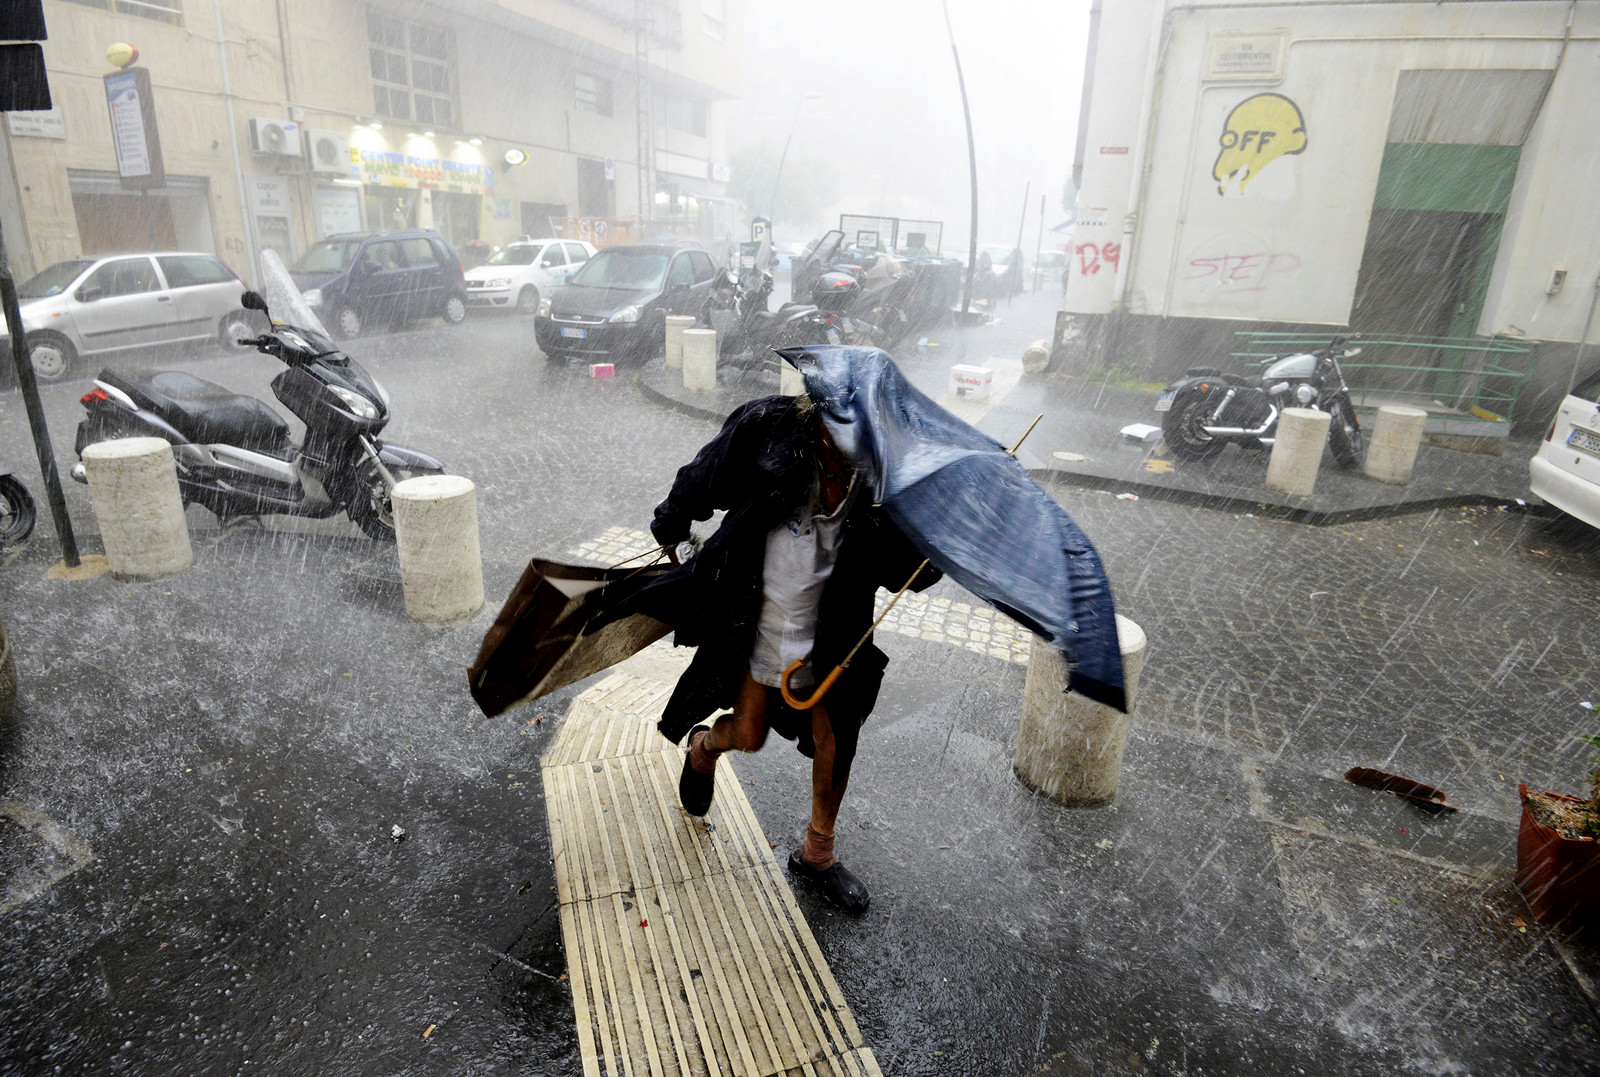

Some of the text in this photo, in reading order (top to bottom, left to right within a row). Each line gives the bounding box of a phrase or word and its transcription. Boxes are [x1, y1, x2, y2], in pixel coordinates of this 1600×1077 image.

[1220, 130, 1276, 153] OFF
[361, 150, 405, 164] CENTER
[408, 155, 439, 167] POINT
[754, 225, 764, 239] P
[1182, 253, 1302, 289] STEP
[958, 376, 981, 386] nutella
